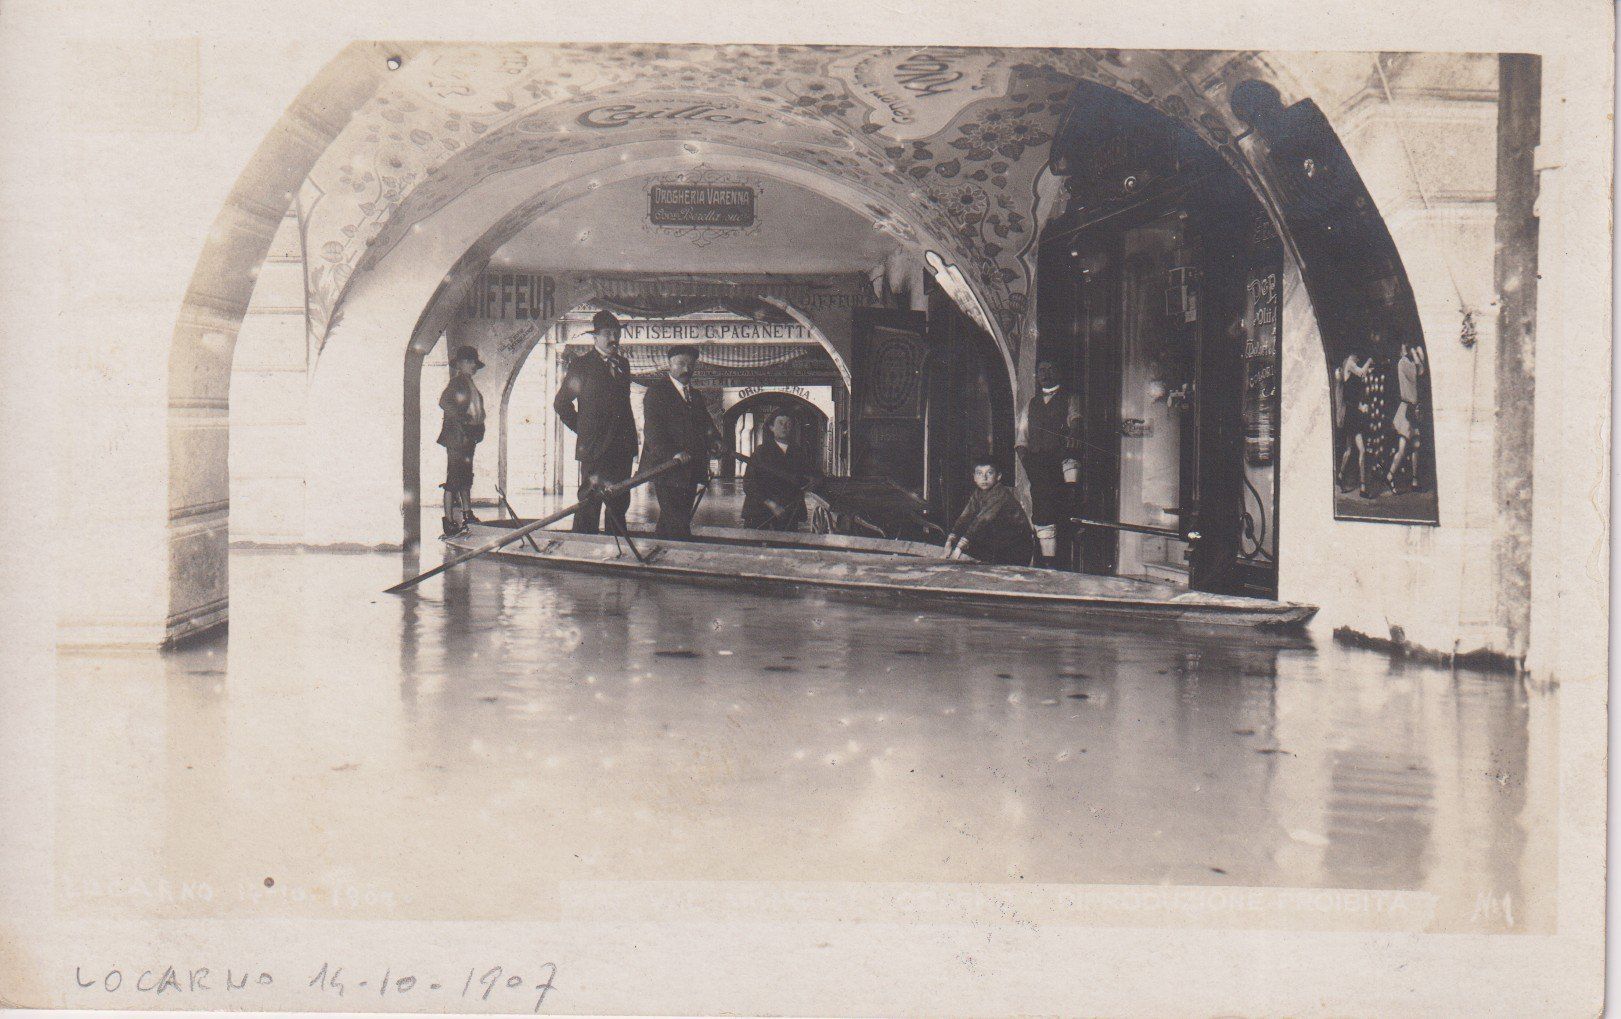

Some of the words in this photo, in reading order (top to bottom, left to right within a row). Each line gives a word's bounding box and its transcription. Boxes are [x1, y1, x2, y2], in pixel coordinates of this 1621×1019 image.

[655, 188, 705, 205] DROGHERIA
[706, 188, 750, 206] VARENNA
[720, 325, 811, 339] PAGANETTI
[76, 965, 273, 995] LOCARNO
